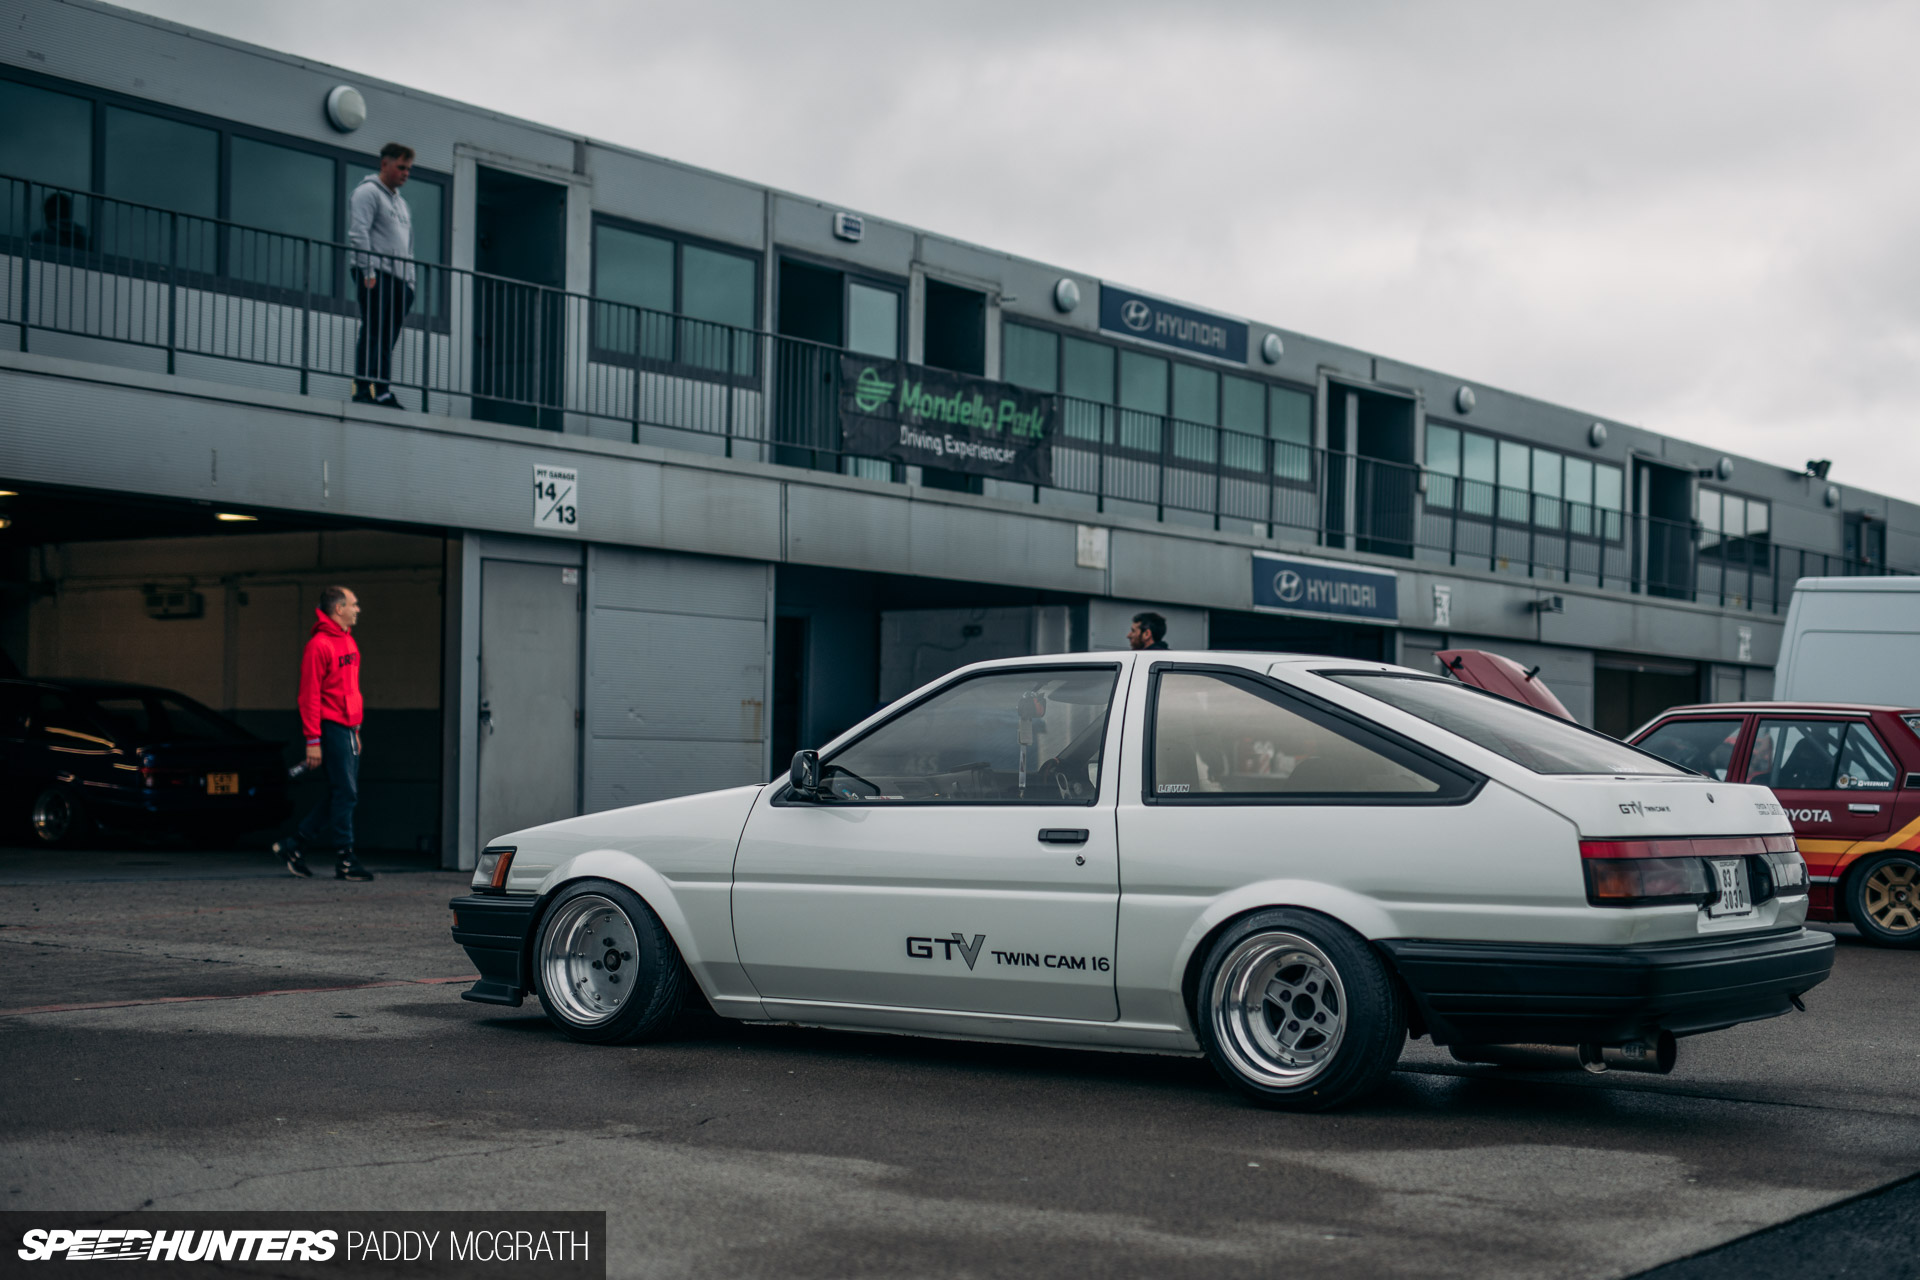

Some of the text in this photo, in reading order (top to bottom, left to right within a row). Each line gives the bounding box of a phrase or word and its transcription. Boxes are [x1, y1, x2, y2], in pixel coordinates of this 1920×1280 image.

[1155, 311, 1227, 350] HYUNDAI
[899, 379, 1044, 439] Mondello Park
[900, 425, 943, 455] Driving
[537, 469, 575, 480] PIT GARAGE
[535, 481, 556, 500] 14
[556, 505, 576, 525] 13
[1306, 578, 1377, 608] HYUNDAI
[1158, 784, 1189, 793] LEVIN
[1618, 801, 1645, 818] GTV
[1734, 868, 1740, 887] C
[1724, 889, 1743, 910] 3030
[906, 932, 1110, 971] GTV TWIN CAM 16
